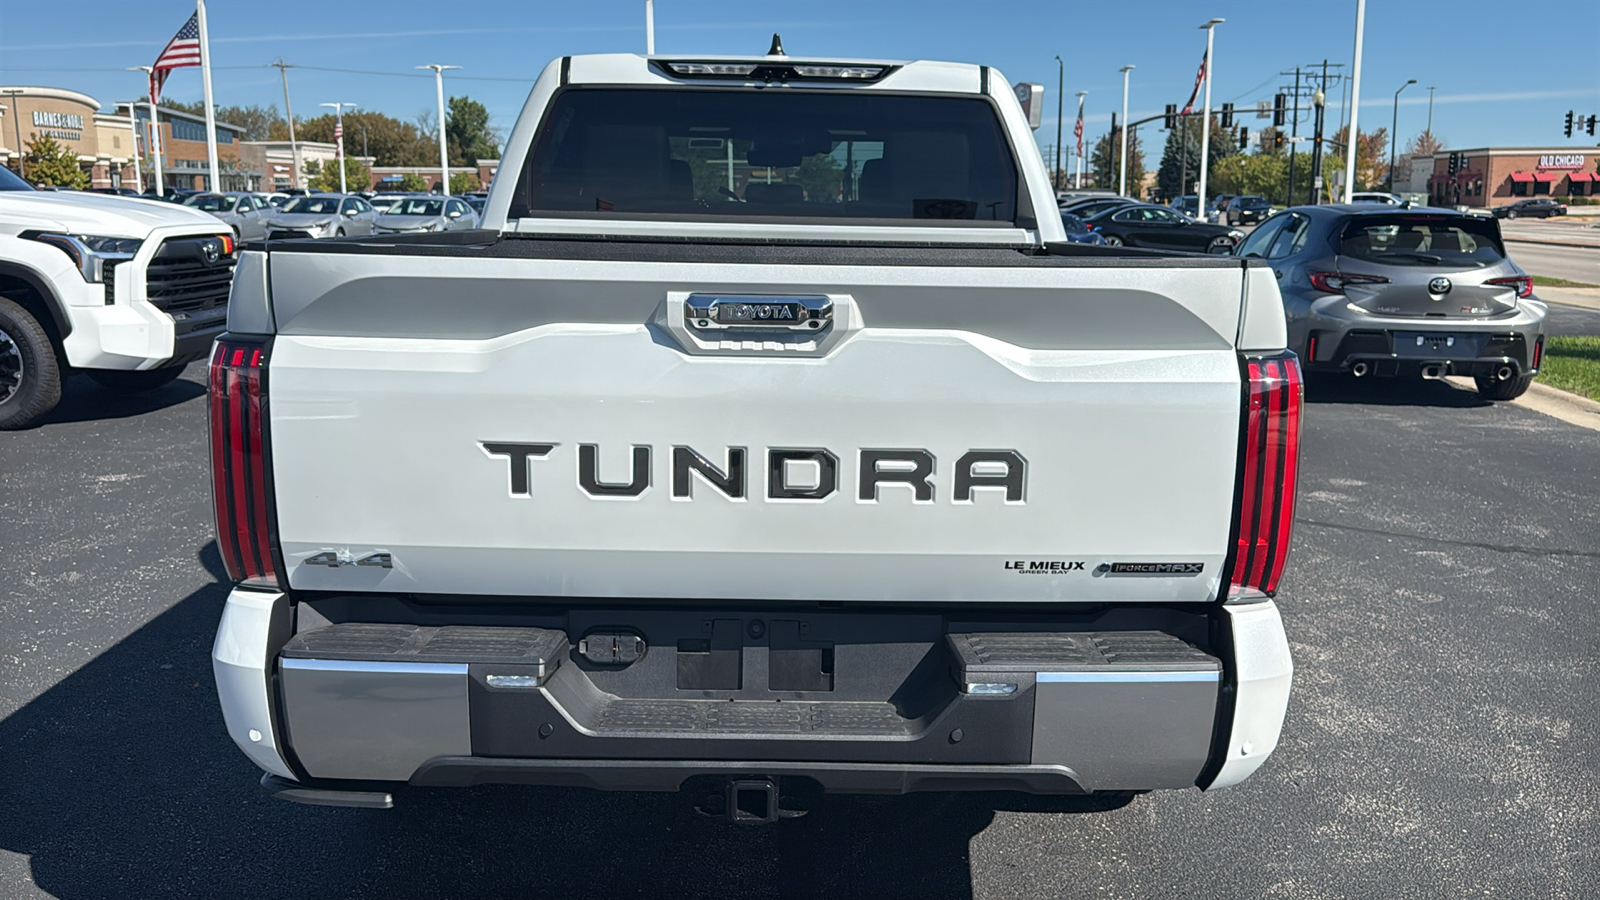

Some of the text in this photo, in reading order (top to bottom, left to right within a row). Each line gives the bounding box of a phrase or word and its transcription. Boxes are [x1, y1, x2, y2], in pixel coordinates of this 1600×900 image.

[1540, 155, 1585, 166] OLD CHICAGO
[724, 304, 794, 319] TOYOTA
[477, 441, 1030, 506] TUNDRA
[1004, 560, 1086, 571] LE MIEUX
